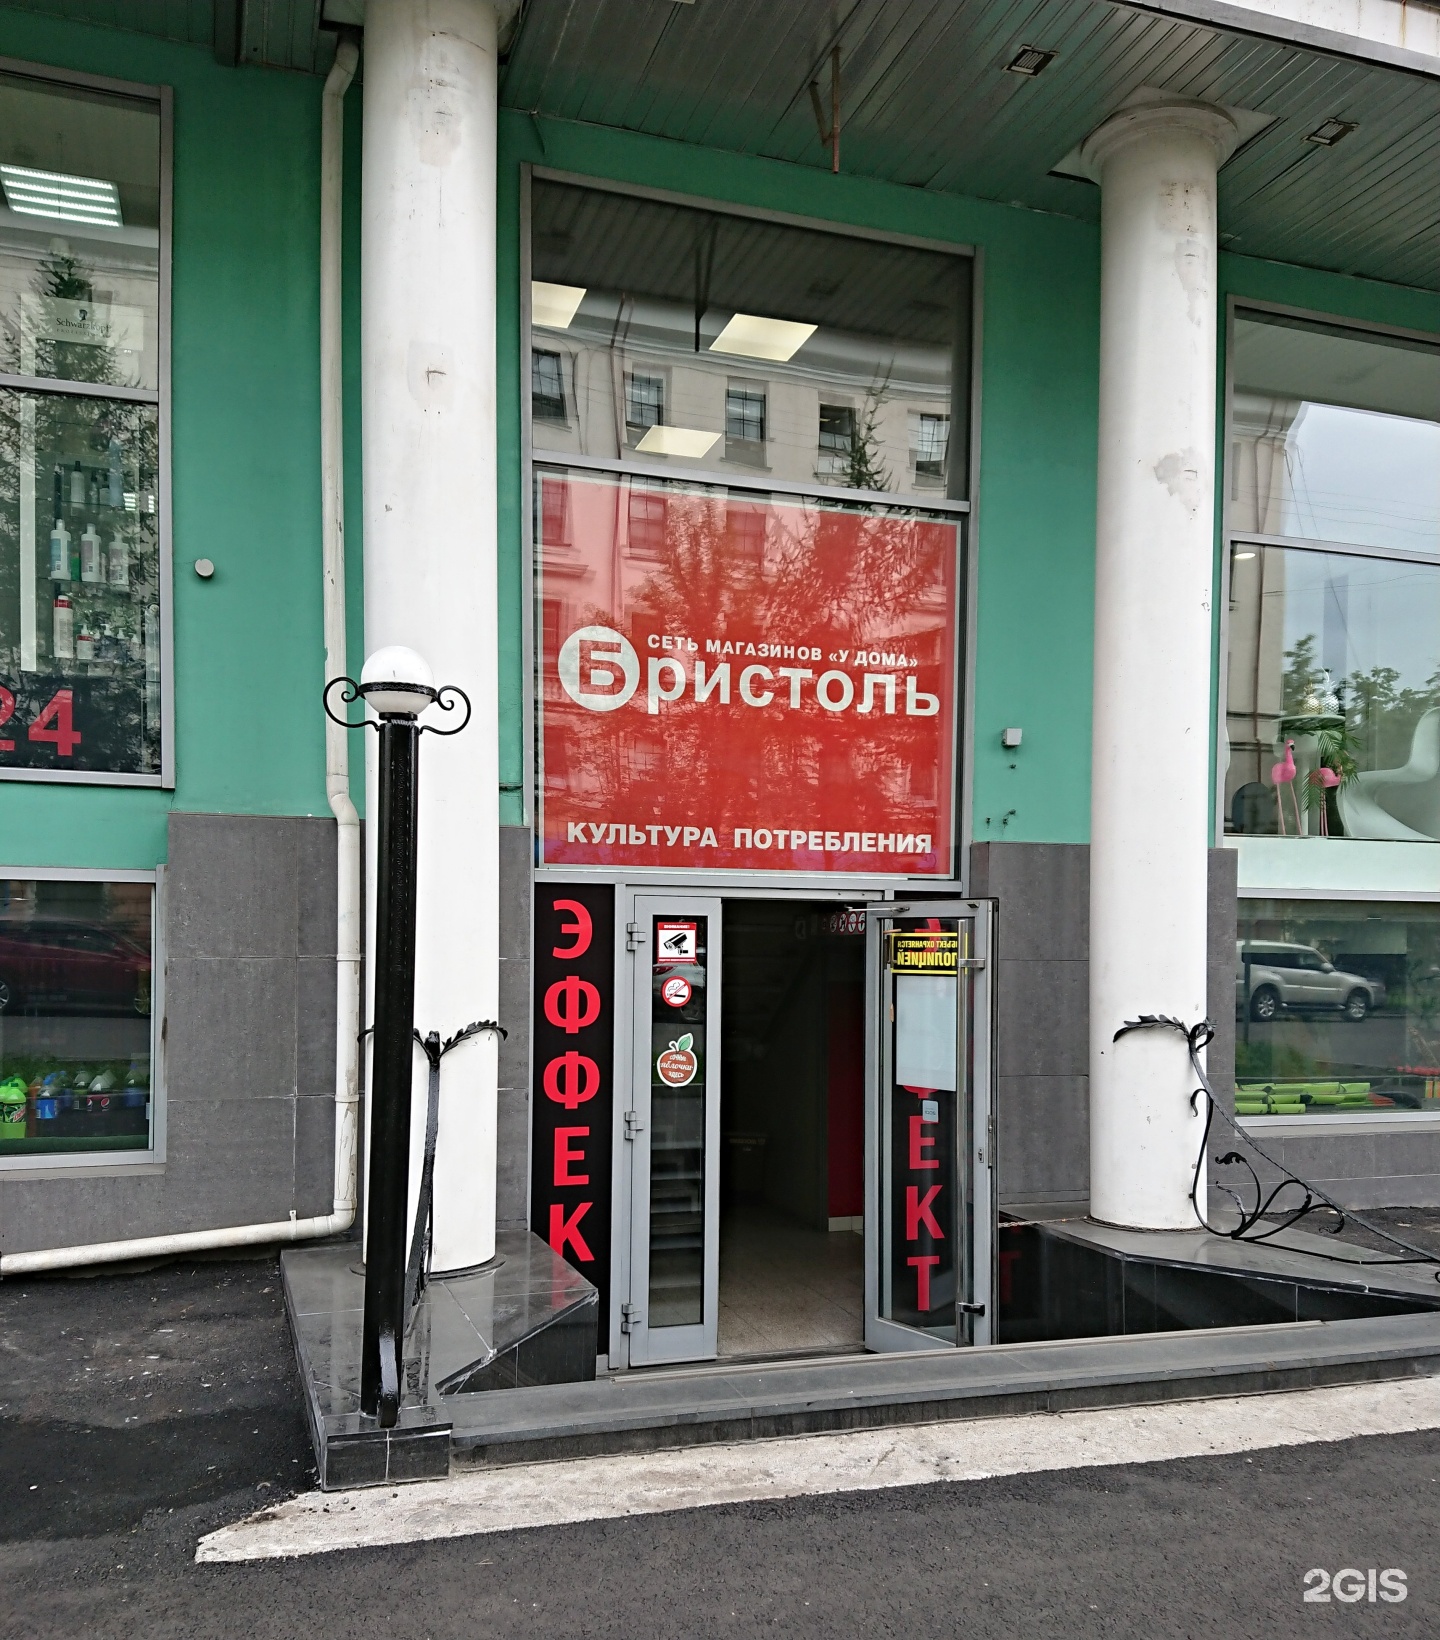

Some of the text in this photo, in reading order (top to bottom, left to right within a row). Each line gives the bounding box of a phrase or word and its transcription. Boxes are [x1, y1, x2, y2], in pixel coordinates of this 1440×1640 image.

[56, 318, 112, 333] Schwarzkopf
[647, 634, 918, 668] СЕТЬ МАГАЗИНОВ «У ДОМА»
[567, 822, 932, 854] КУЛЬТУРА ПОТРЕБЛЕНИЯ
